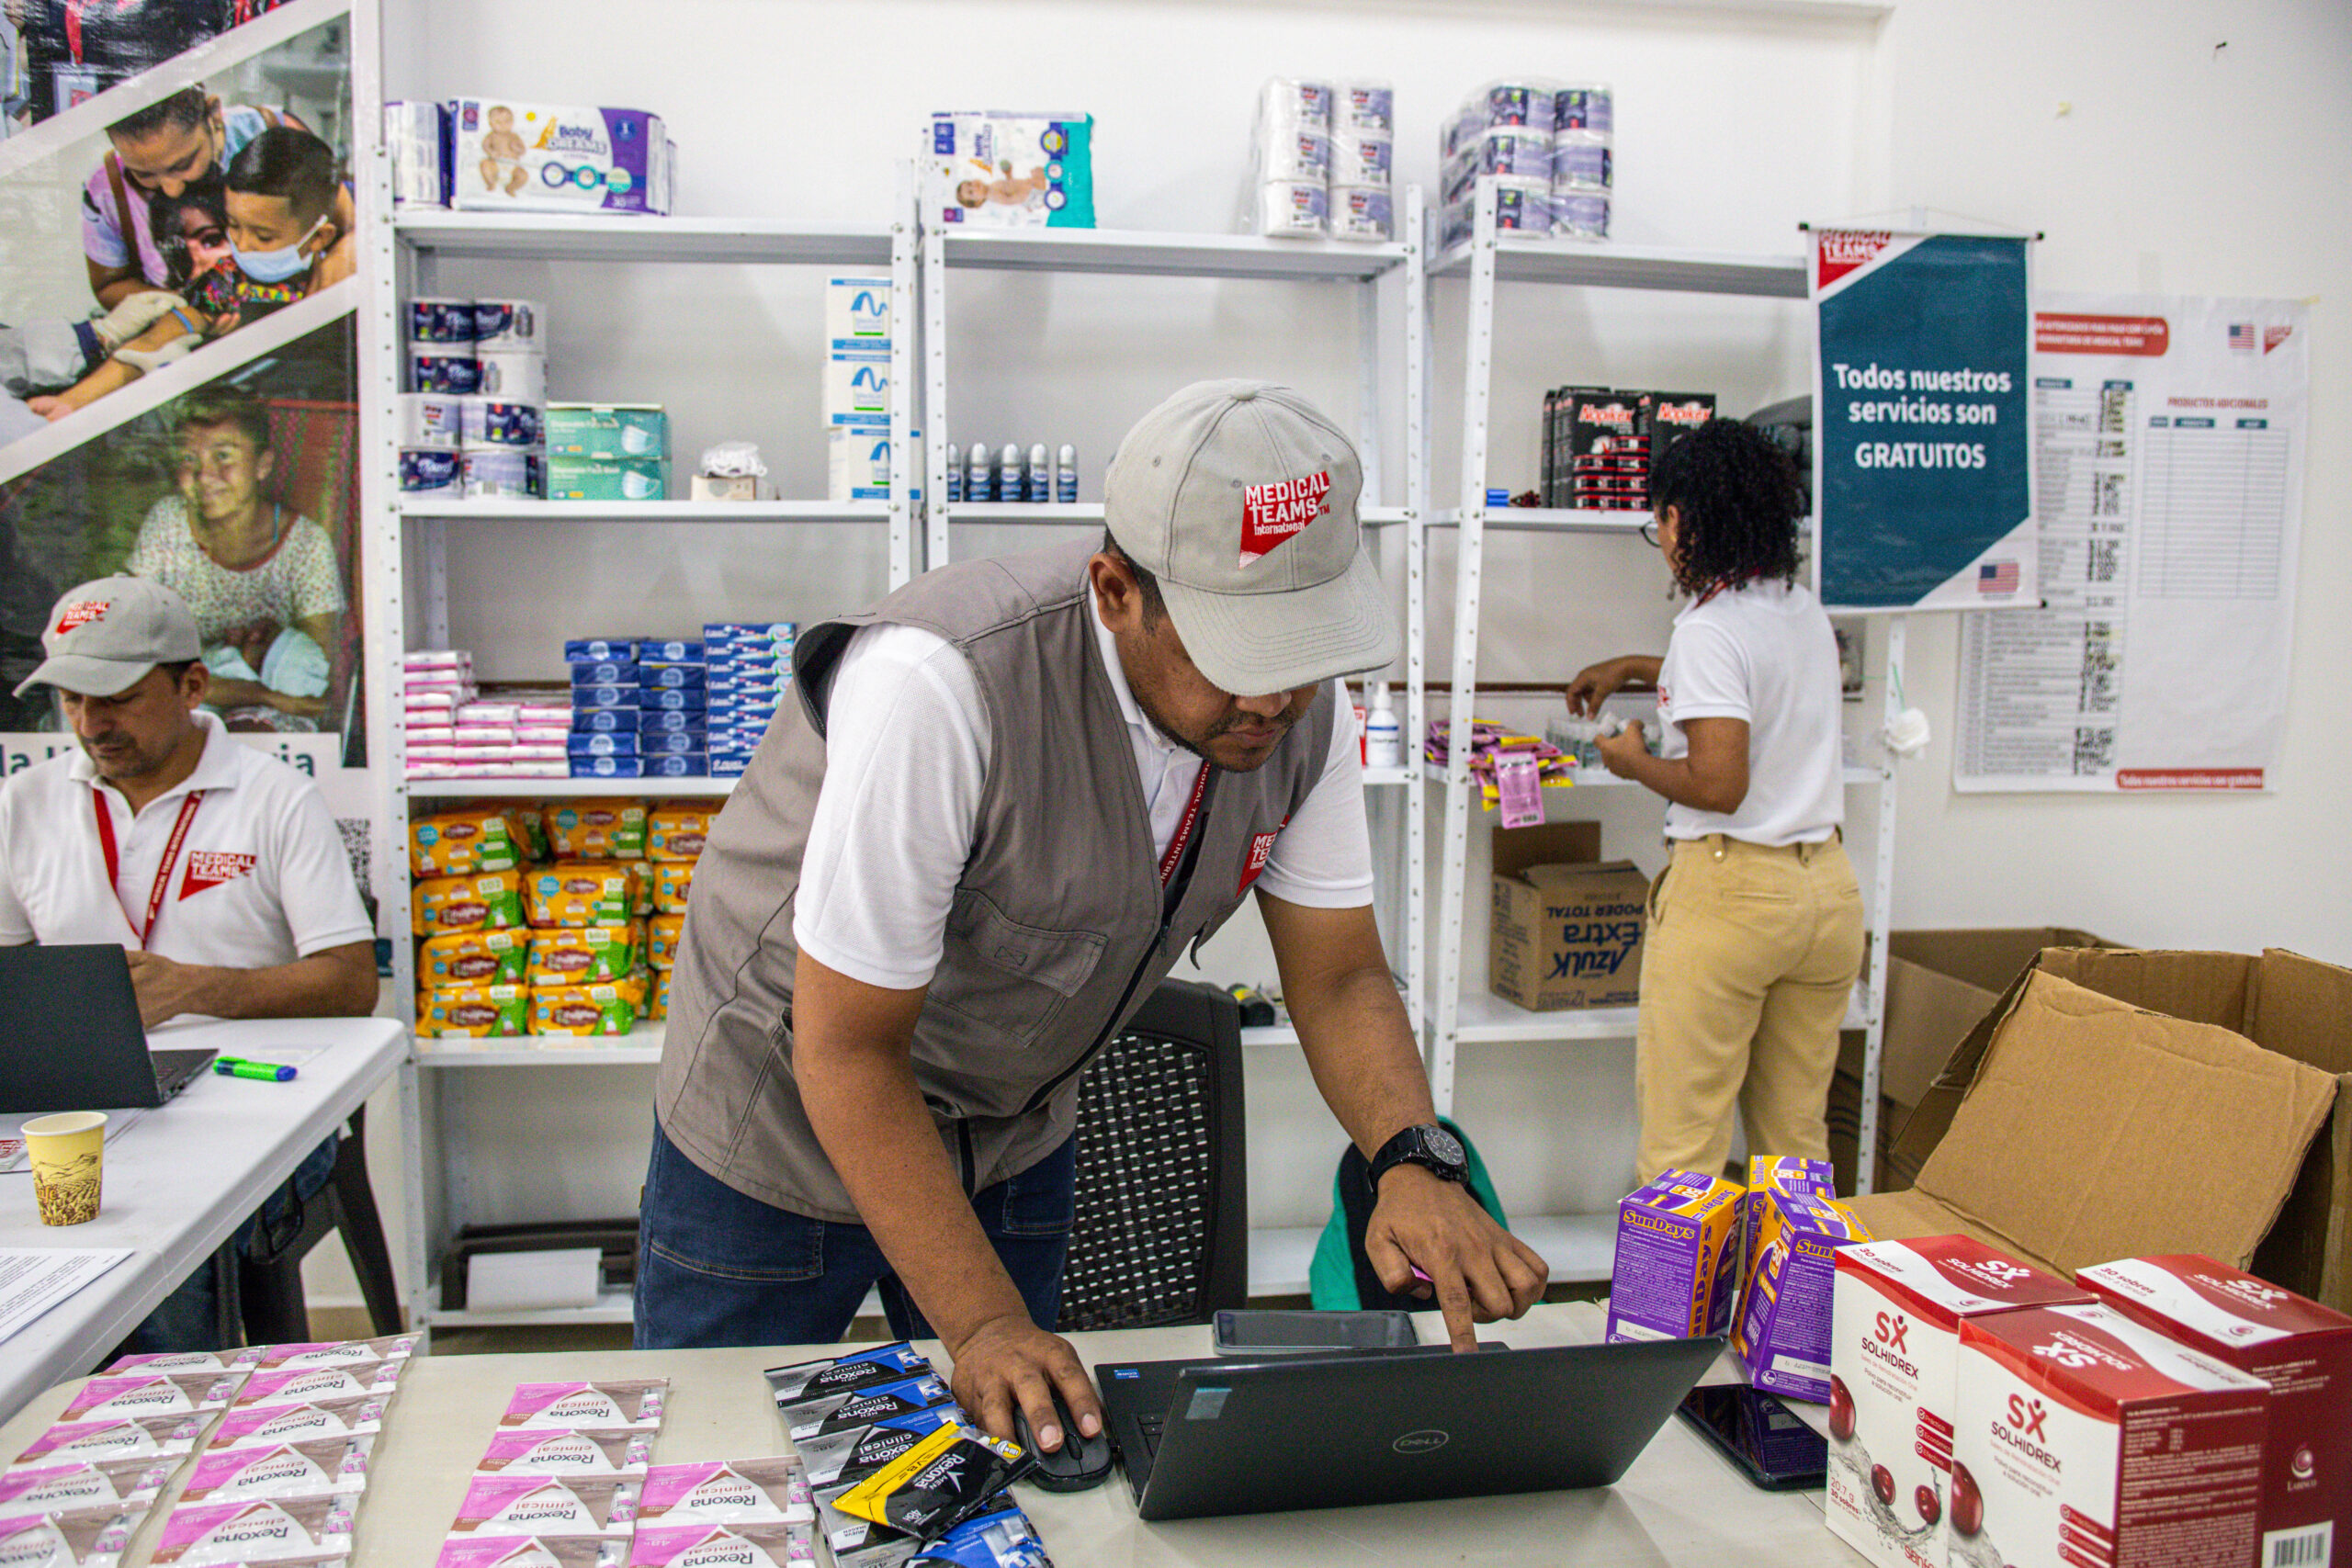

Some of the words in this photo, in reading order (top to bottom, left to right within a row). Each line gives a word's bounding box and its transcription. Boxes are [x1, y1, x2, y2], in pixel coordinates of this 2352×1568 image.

[1834, 364, 1905, 390] Todos
[1911, 369, 2011, 393] nuestros
[1849, 397, 1951, 423] servicios
[1956, 404, 1996, 424] son
[1855, 443, 1986, 468] GRATUITOS
[1245, 472, 1330, 505] MEDICAL
[1249, 497, 1317, 525] TEAMS
[1254, 520, 1306, 536] International
[1180, 808, 1196, 845] TEAMS
[191, 852, 255, 867] MEDICAL
[191, 863, 241, 877] TEAMS
[1545, 906, 1589, 919] TOTAL
[1564, 922, 1642, 948] Extra
[1623, 1210, 1695, 1239] SunDays
[2099, 1268, 2117, 1278] 30
[2117, 1275, 2156, 1294] sobres
[1874, 1311, 1908, 1355] SX
[302, 1348, 363, 1360] Rexona
[1861, 1337, 1919, 1381] SOLHIDREX
[820, 1366, 877, 1383] Rexona
[284, 1379, 345, 1396] Rexona
[110, 1394, 175, 1408] Rexona
[556, 1400, 608, 1409] clinical
[549, 1408, 610, 1418] Rexona
[837, 1402, 899, 1420] Rexona
[2007, 1393, 2047, 1444] SX
[261, 1418, 326, 1438] Rexona
[69, 1436, 139, 1450] Rexona
[537, 1445, 593, 1454] clinical
[859, 1433, 912, 1454] clinical
[1400, 1438, 1442, 1447] DELL
[1991, 1421, 2061, 1473] SOLHIDREX
[530, 1453, 594, 1464] Rexona
[238, 1468, 308, 1486] Rexona
[914, 1452, 966, 1488] Rexona
[695, 1485, 752, 1496] clinical
[928, 1475, 948, 1492] MEN
[26, 1486, 100, 1502] Rexona
[691, 1495, 755, 1507] Rexona
[515, 1501, 574, 1510] clinical
[507, 1509, 577, 1521] Rexona
[212, 1526, 288, 1545] Rexona
[688, 1544, 749, 1555] clinical
[683, 1551, 753, 1568] Rexona
